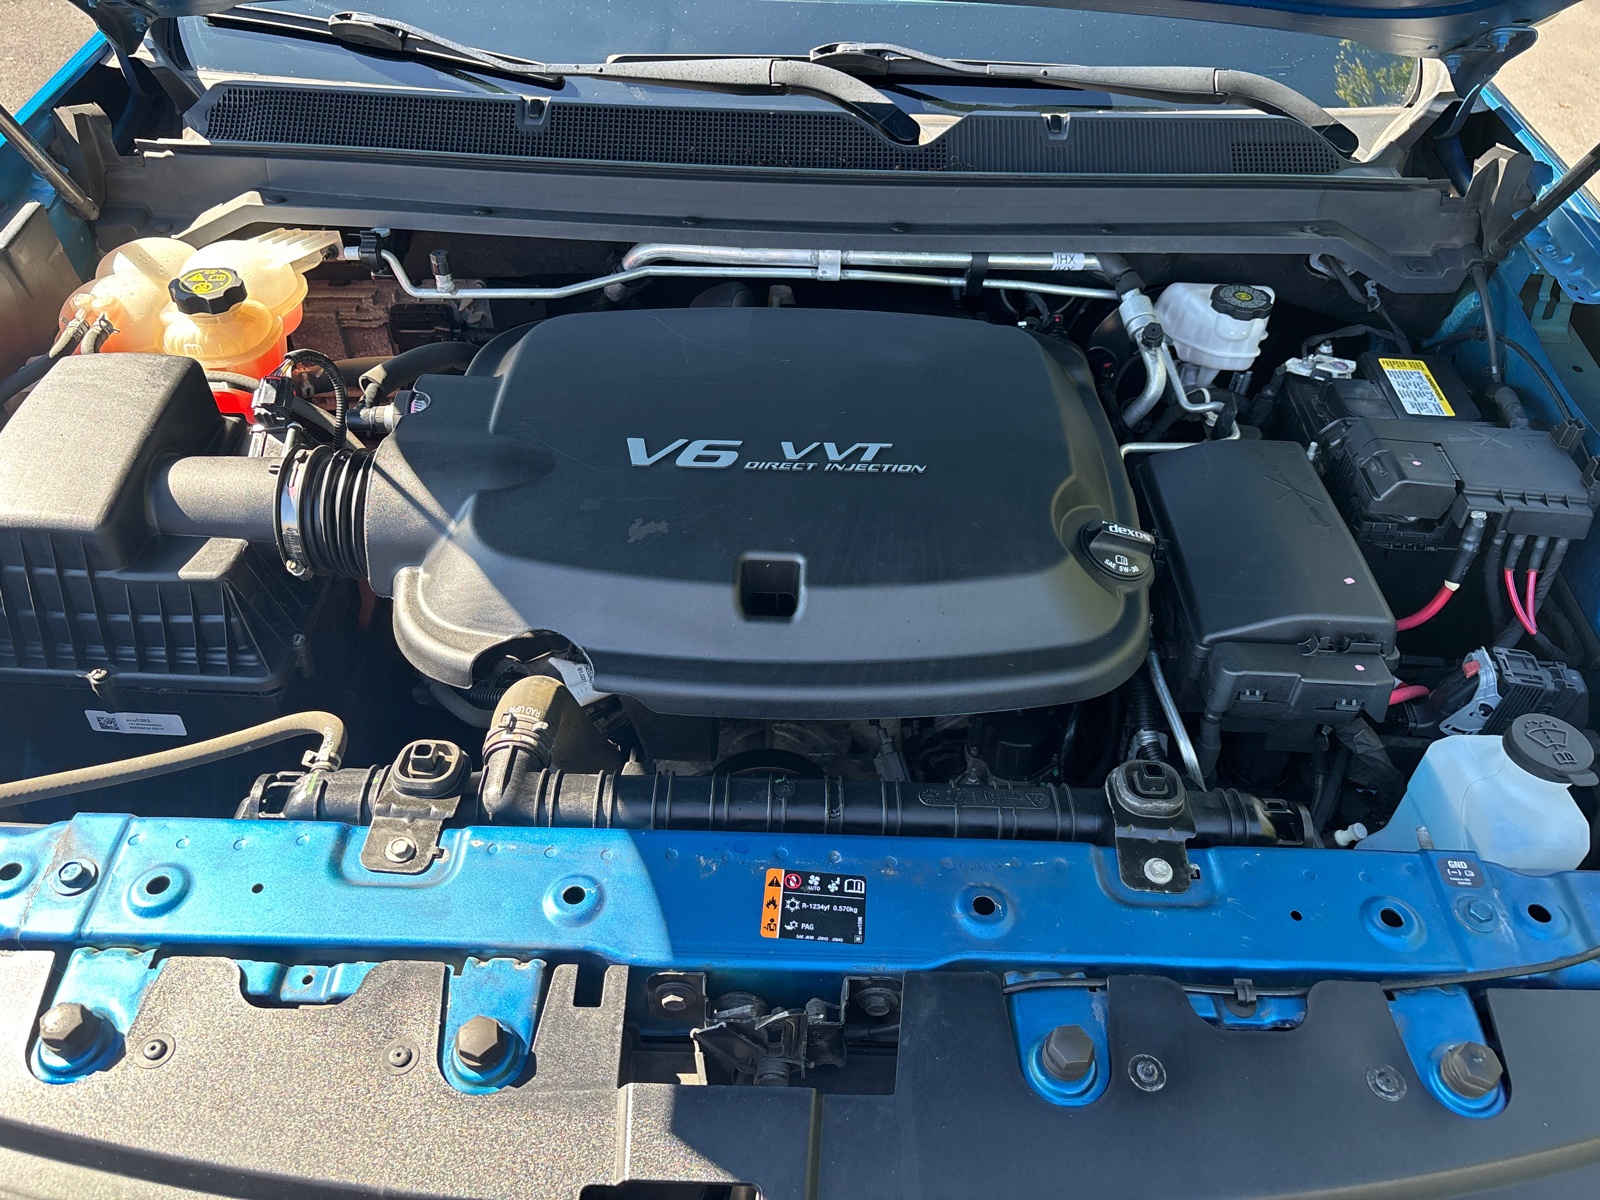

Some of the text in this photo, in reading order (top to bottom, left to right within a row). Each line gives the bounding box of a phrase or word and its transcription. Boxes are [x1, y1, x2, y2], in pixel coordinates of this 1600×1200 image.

[1056, 254, 1076, 265] IHX
[626, 437, 744, 469] V6
[780, 441, 894, 462] VVT
[743, 462, 928, 474] DIRECT INJECTION
[1108, 524, 1151, 541] dexos
[1104, 559, 1139, 573] SAE 5W-30
[526, 706, 540, 718] RAD
[1447, 860, 1467, 869] GND
[802, 903, 857, 913] R-1234yf 0.570kg
